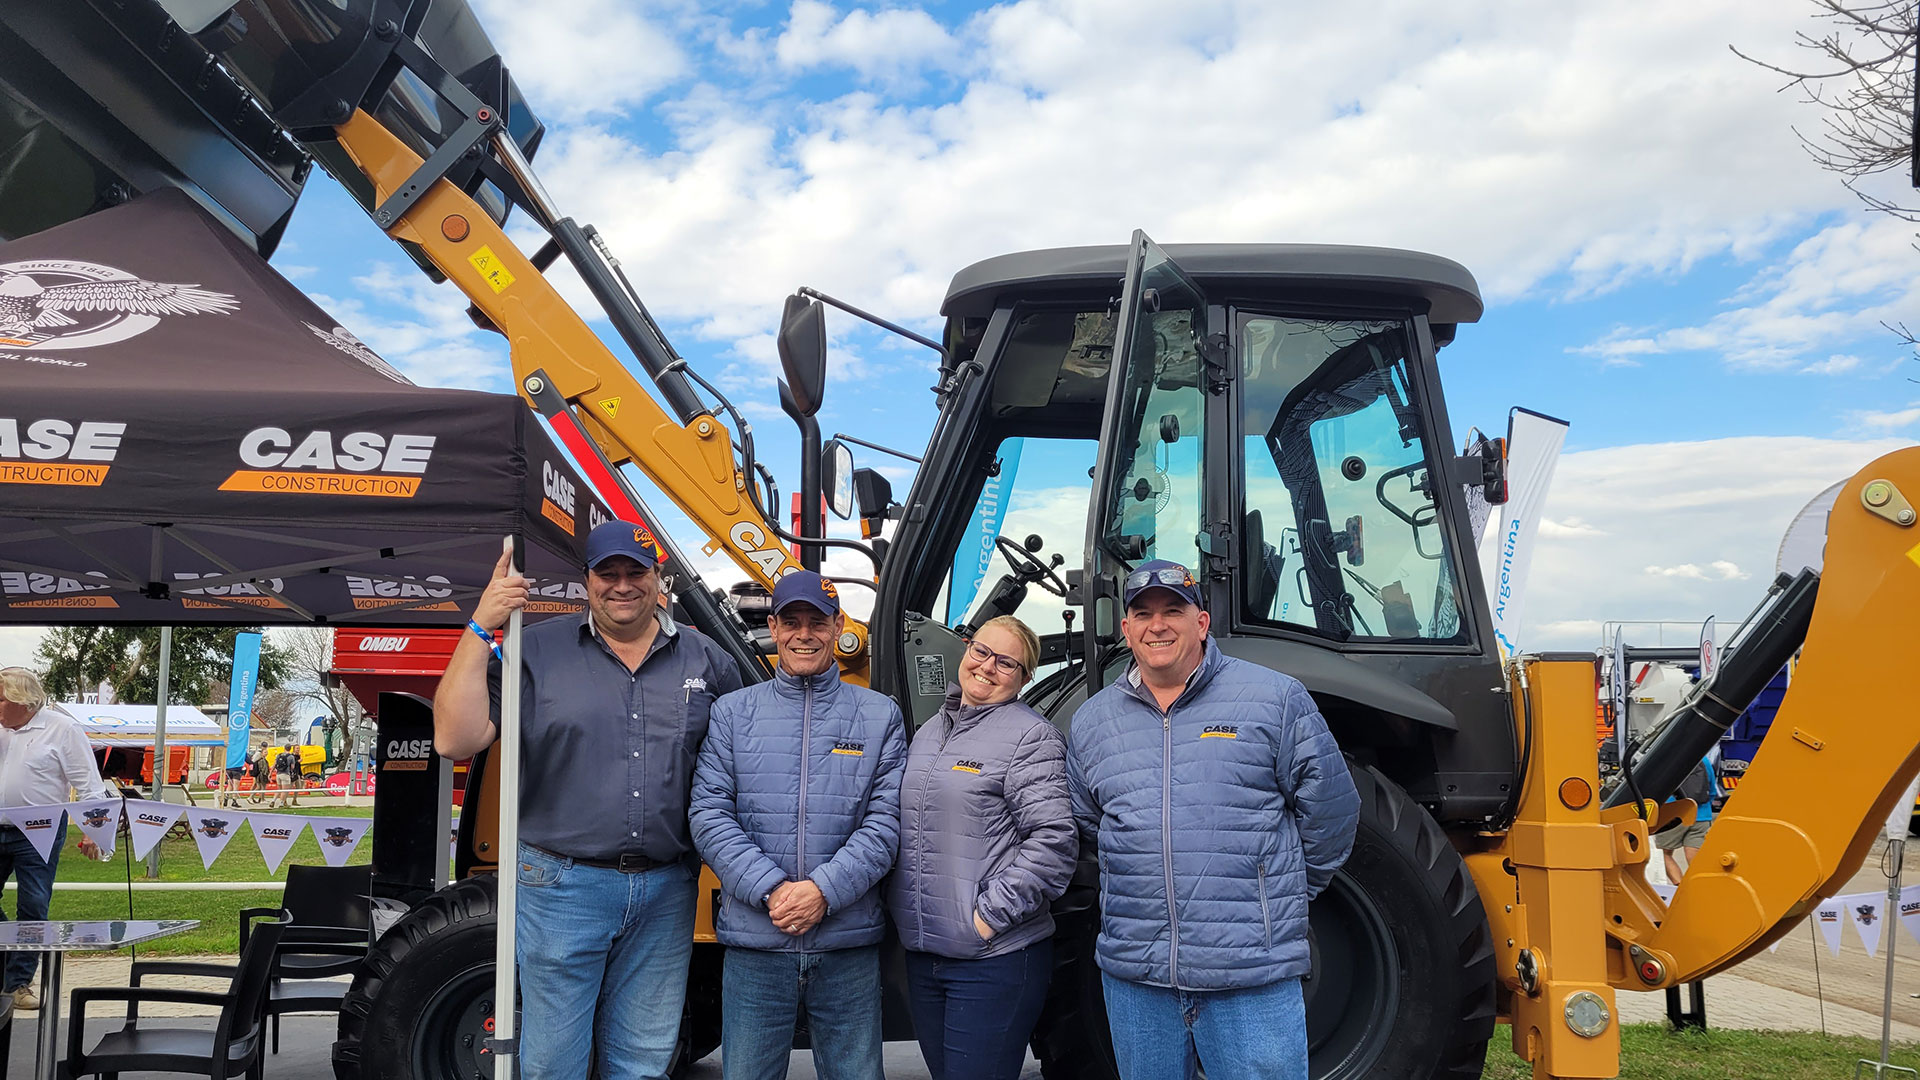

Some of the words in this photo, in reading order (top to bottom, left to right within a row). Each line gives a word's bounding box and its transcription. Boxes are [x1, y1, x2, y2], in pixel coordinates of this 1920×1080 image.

[79, 266, 114, 277] 1842
[25, 357, 88, 367] WORLD
[239, 427, 437, 473] CASE
[262, 475, 412, 494] CONSTRUCTION
[543, 460, 575, 517] CASE
[590, 503, 609, 531] CA
[974, 470, 1002, 592] Argentin
[729, 521, 800, 585] CA
[1496, 519, 1520, 621] Argentina
[359, 636, 410, 652] OMBU
[238, 670, 250, 708] Argentina
[1203, 725, 1239, 733] CASE
[387, 740, 432, 758] CASE
[835, 743, 864, 751] CASE
[956, 760, 984, 769] CASE
[138, 813, 168, 824] CASE
[263, 828, 291, 836] CASE
